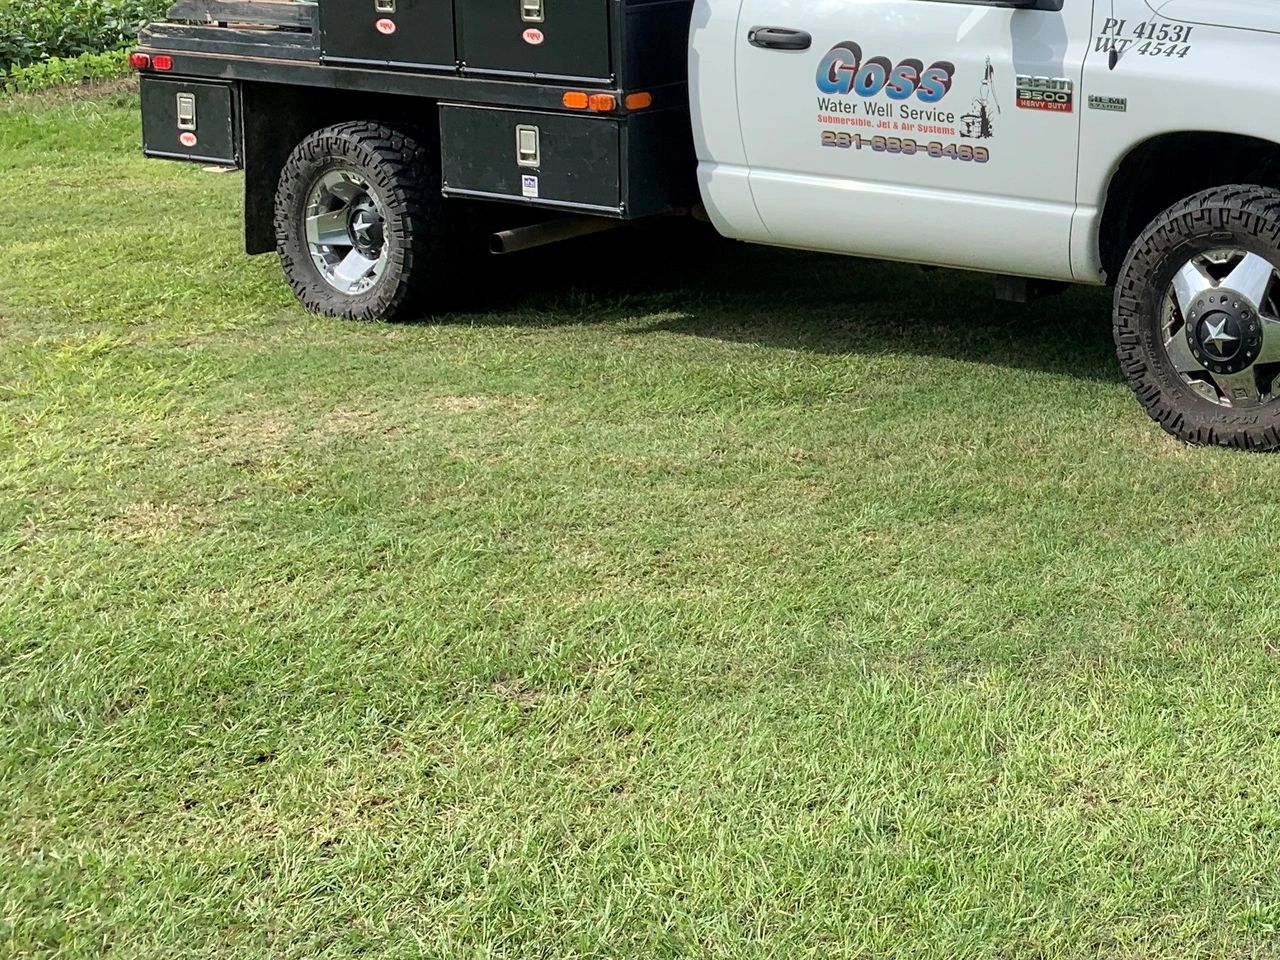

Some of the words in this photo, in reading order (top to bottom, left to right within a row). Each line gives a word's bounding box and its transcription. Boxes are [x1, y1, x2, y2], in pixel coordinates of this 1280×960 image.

[1100, 17, 1127, 36] PI
[1094, 36, 1133, 54] WT
[1136, 41, 1192, 58] 4544
[815, 40, 955, 104] Goss
[1019, 90, 1068, 103] 3500
[1020, 100, 1046, 108] HEAVY
[1047, 102, 1067, 110] DUTY
[816, 97, 858, 115] Water
[863, 101, 893, 117] Well
[900, 105, 955, 124] Service
[876, 120, 891, 130] Jet
[893, 122, 899, 130] &
[901, 122, 915, 131] Air
[917, 124, 955, 136] Systems
